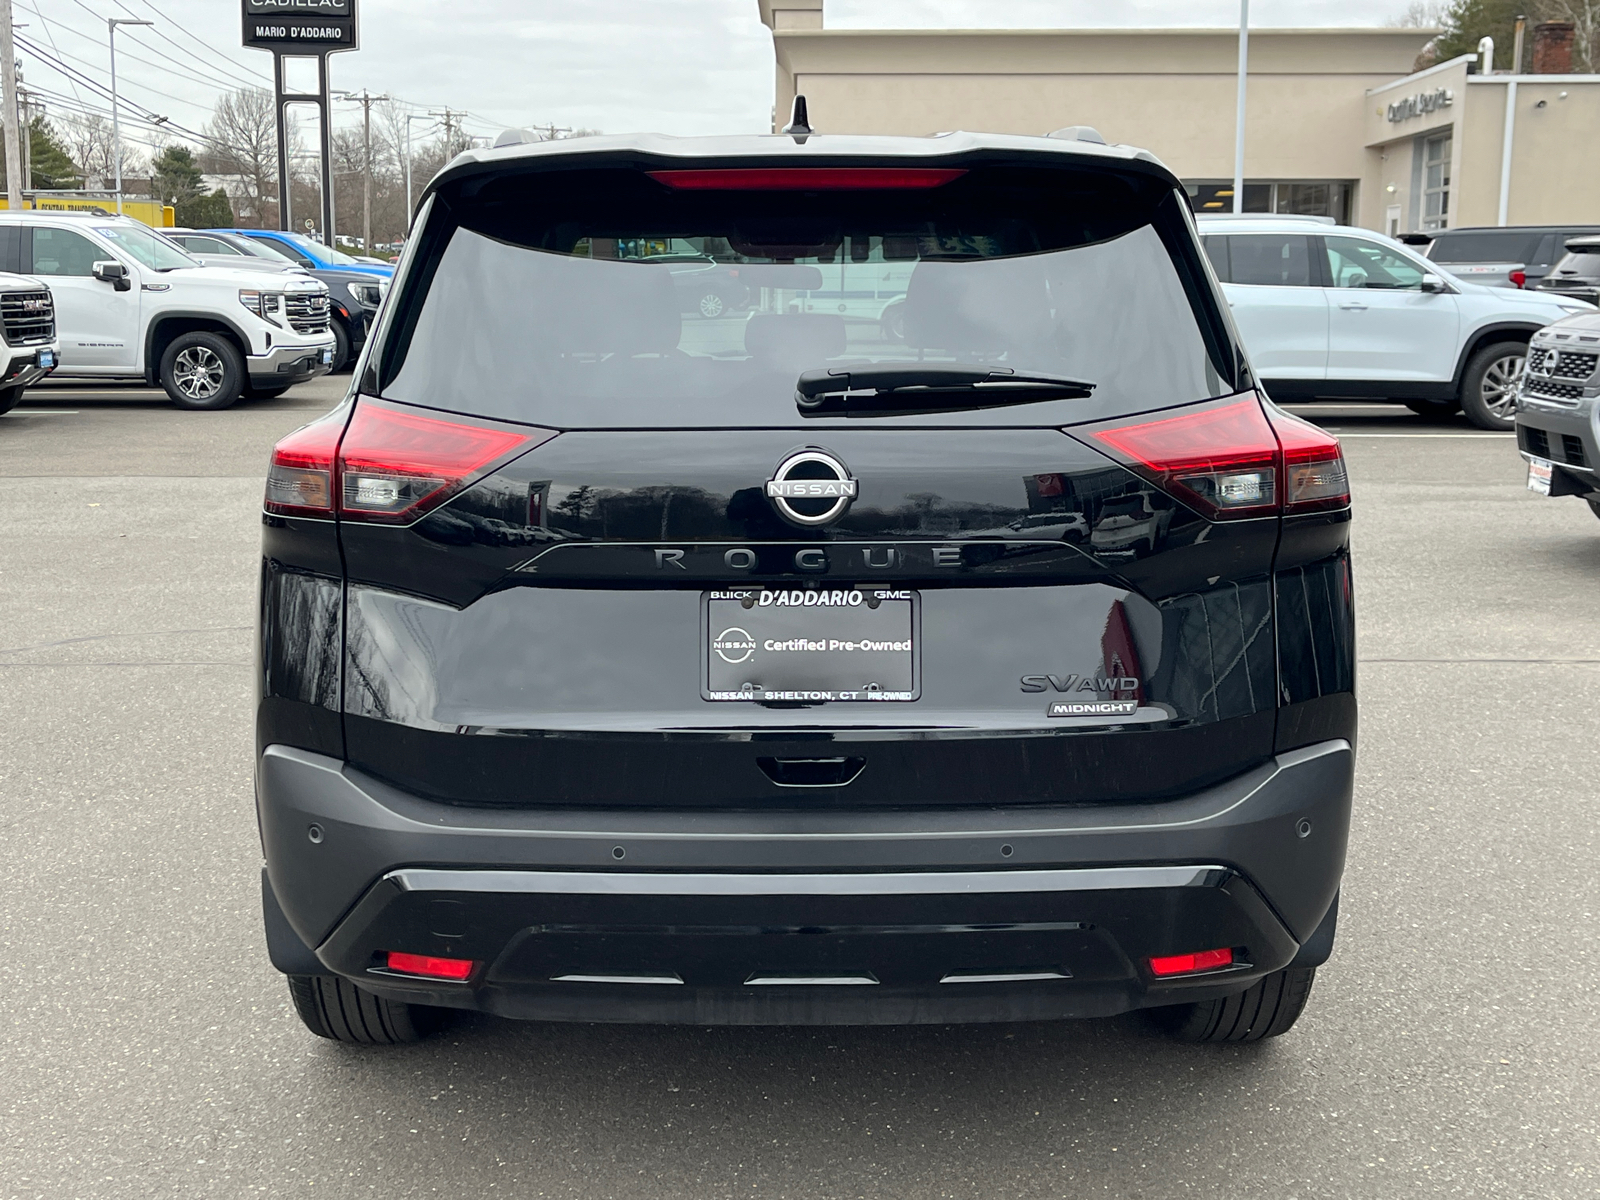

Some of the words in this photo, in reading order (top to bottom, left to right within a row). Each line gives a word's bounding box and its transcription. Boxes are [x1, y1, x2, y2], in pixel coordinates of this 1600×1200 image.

[256, 26, 286, 37] MARIO
[291, 27, 342, 38] D'ADDARIO
[769, 482, 854, 496] NISSAN
[653, 548, 963, 570] ROGUE
[710, 591, 752, 599] BUICK
[758, 590, 863, 607] D'ADDARIO
[874, 591, 911, 599] GMC
[764, 639, 826, 651] Certified
[829, 639, 912, 651] Pre-Owned
[710, 691, 753, 700] NISSAN
[764, 691, 836, 701] SHELTON,
[839, 691, 859, 700] CT
[867, 691, 912, 700] PRE-OWNED
[1053, 703, 1134, 713] MIDNIGHT
